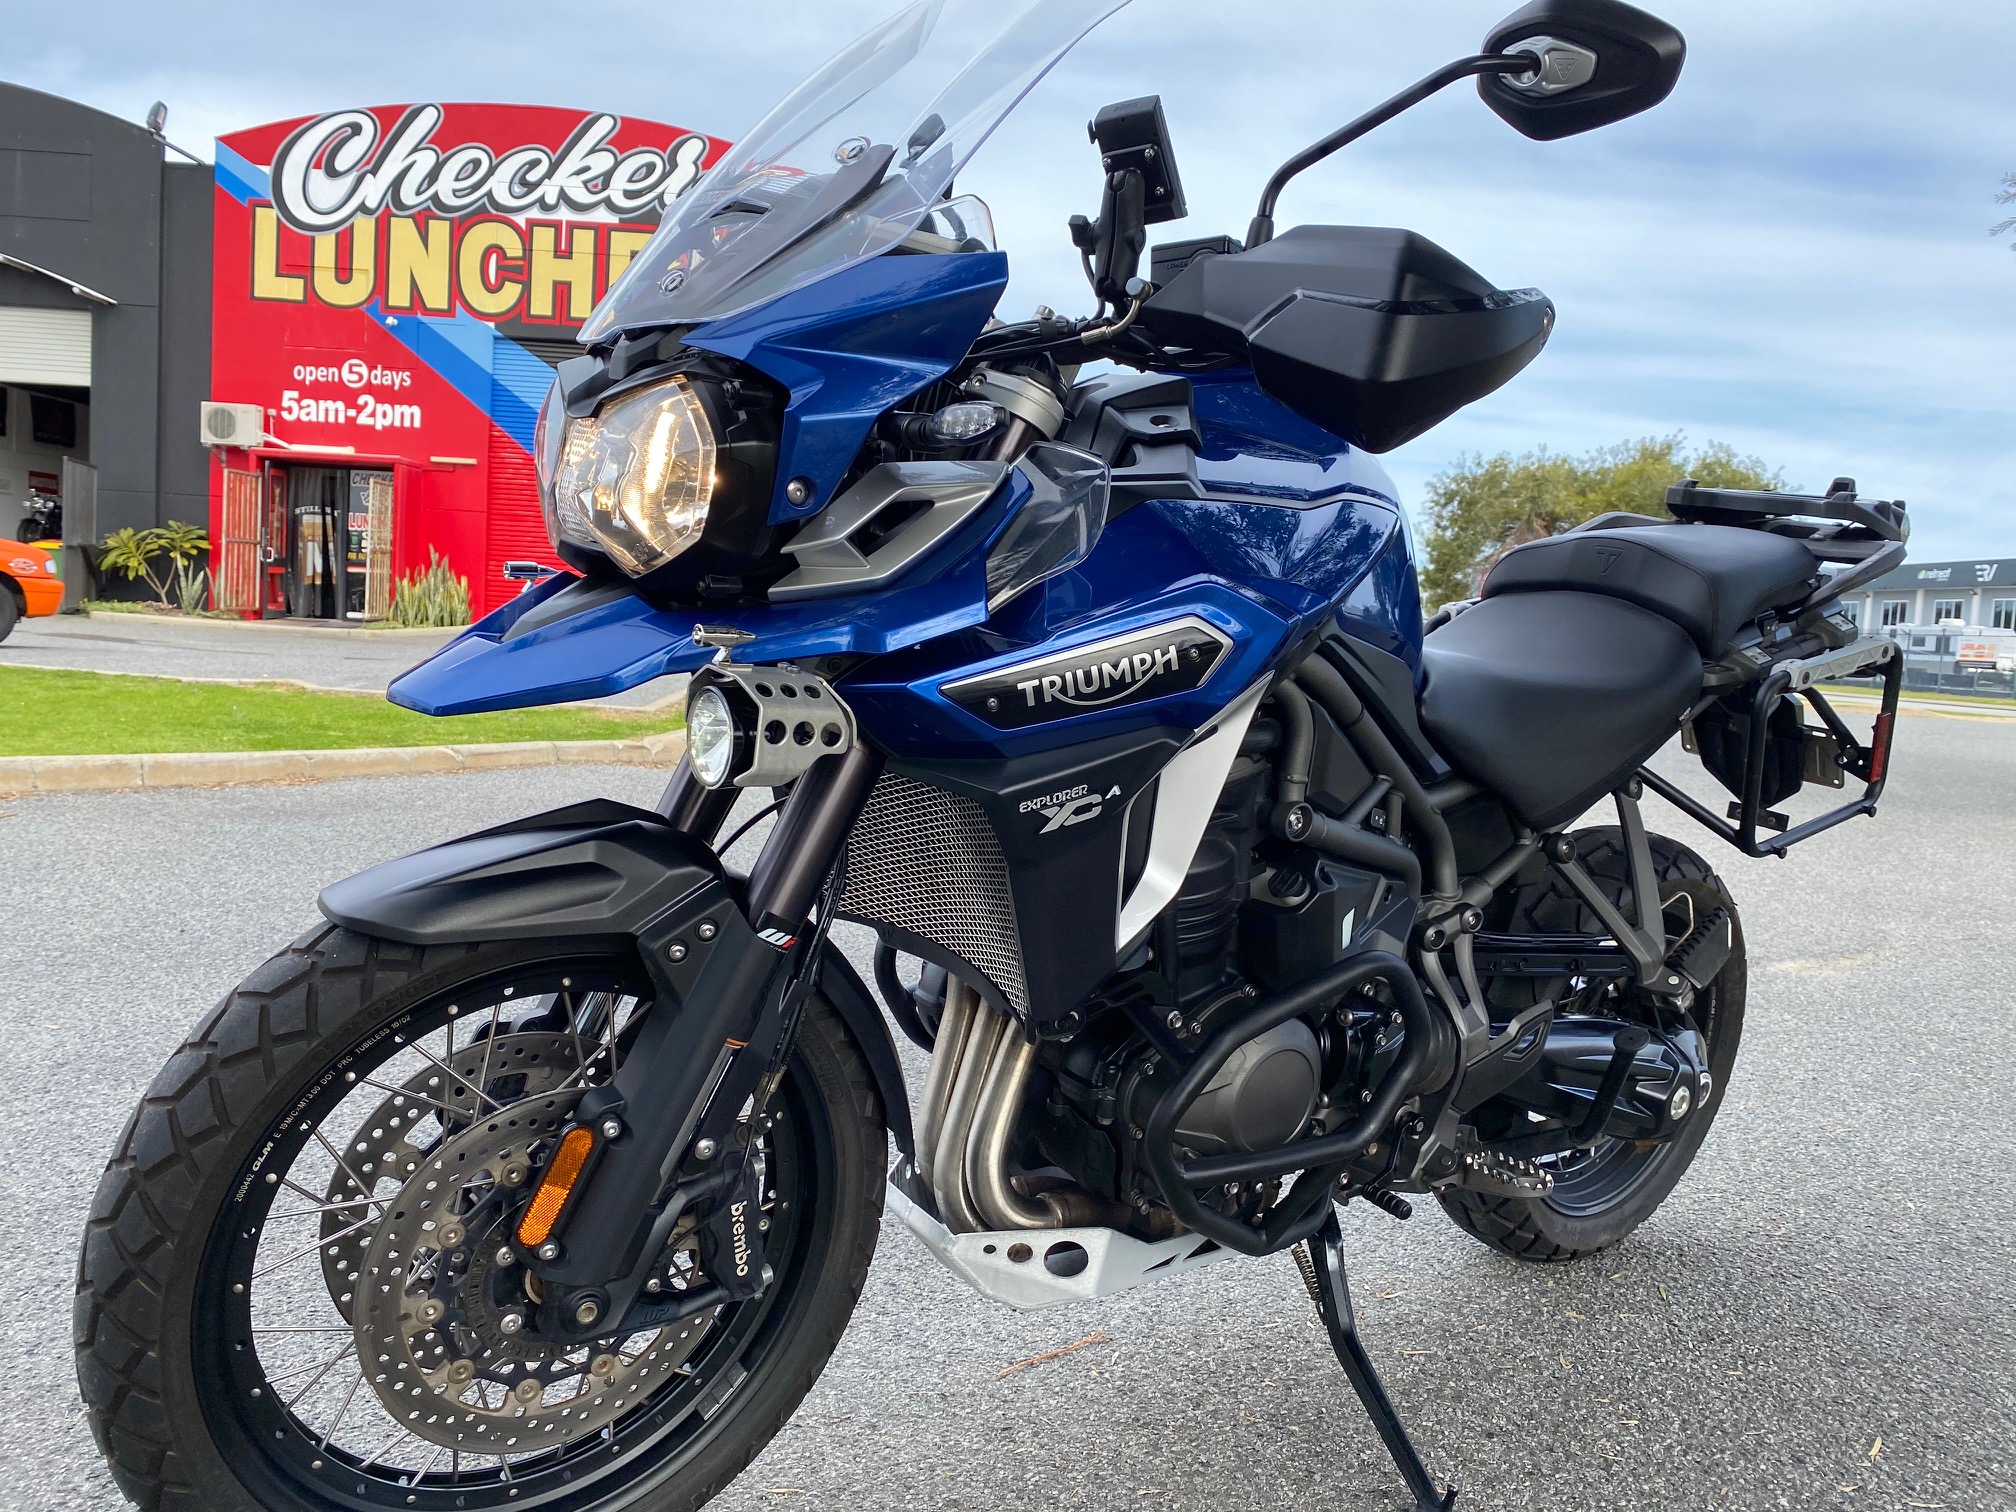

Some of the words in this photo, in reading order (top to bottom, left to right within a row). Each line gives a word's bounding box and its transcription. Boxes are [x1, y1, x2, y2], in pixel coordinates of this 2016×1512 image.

[293, 364, 339, 385] open
[344, 361, 366, 386] 5
[370, 365, 412, 390] days
[281, 390, 422, 431] 5am-2pm
[1017, 644, 1180, 707] TRIUMPH
[1018, 784, 1089, 814] EXPLORER
[234, 1173, 255, 1202] 2000442
[252, 1141, 274, 1171] GLM
[320, 1069, 336, 1085] DOT
[336, 1055, 353, 1070] PRC
[353, 1027, 390, 1054] TUBELESS
[730, 1200, 752, 1276] brembo
